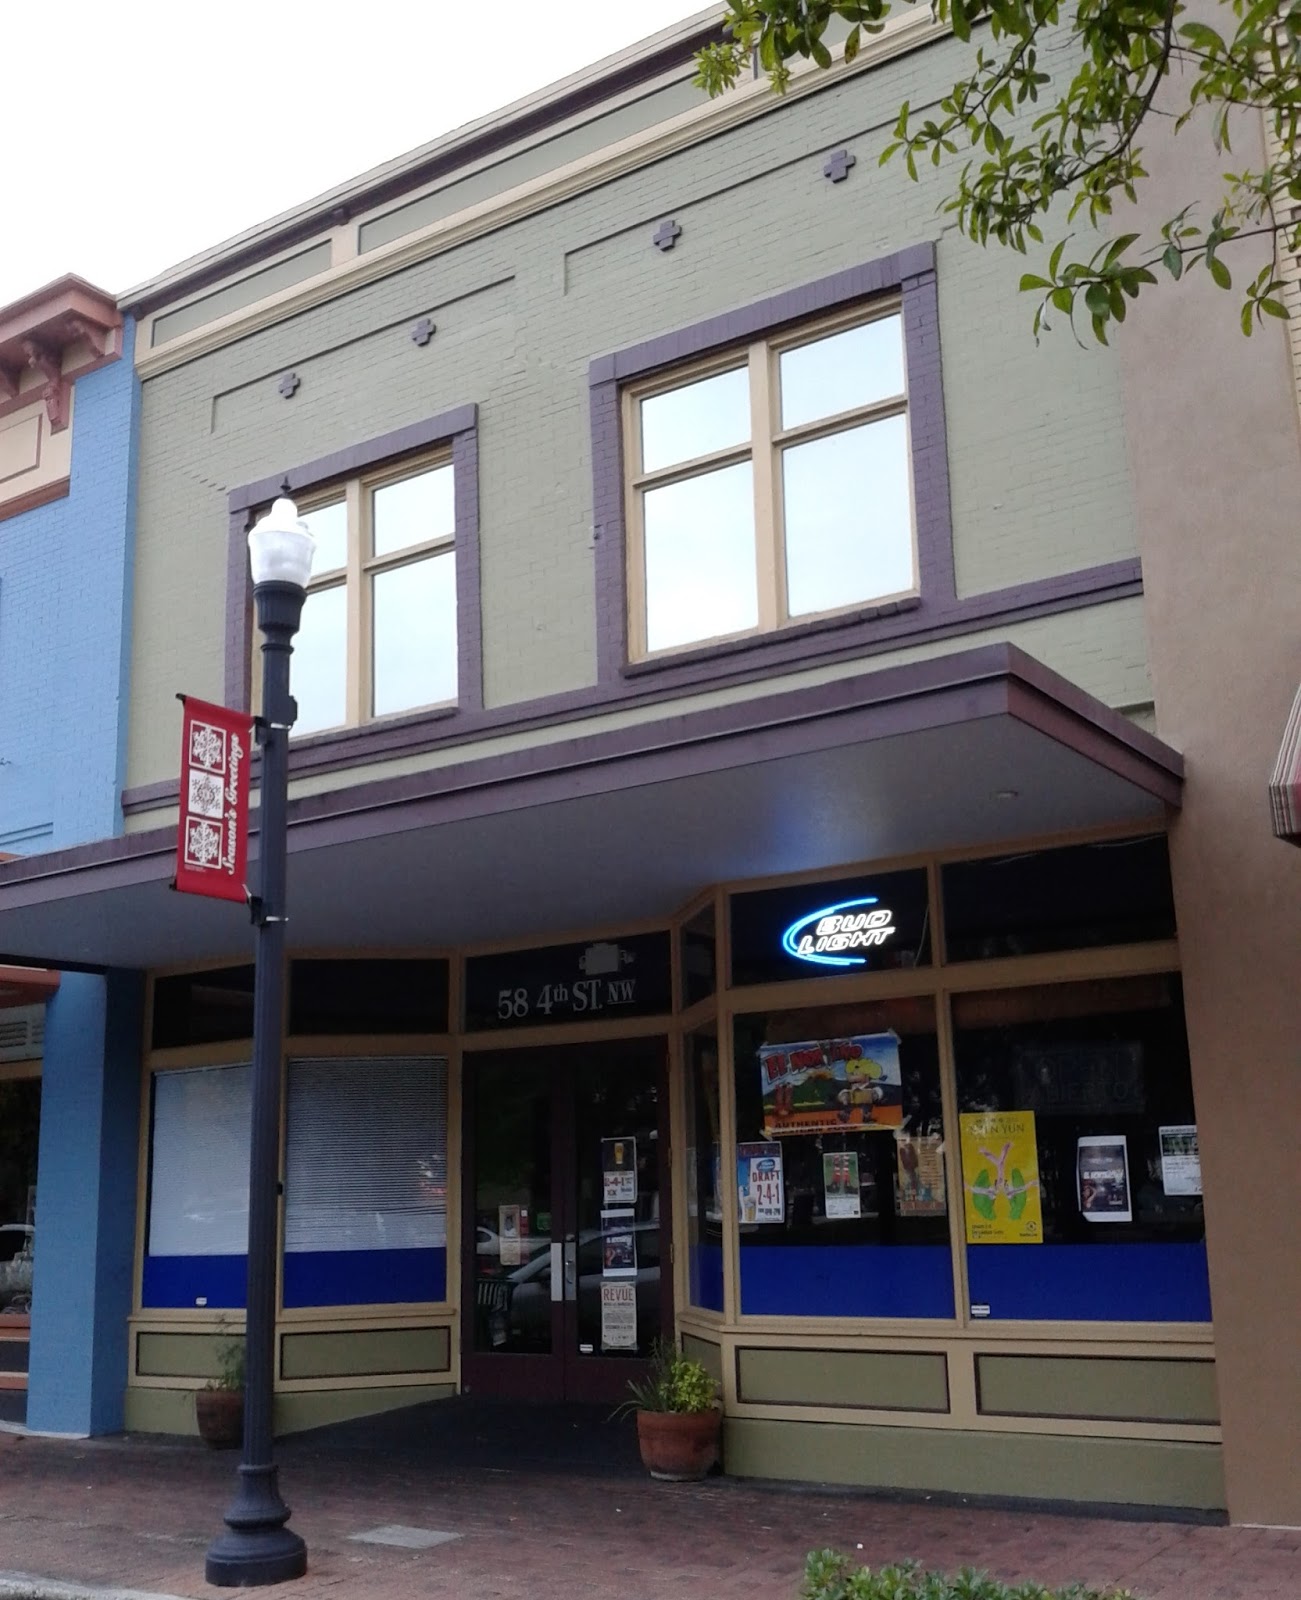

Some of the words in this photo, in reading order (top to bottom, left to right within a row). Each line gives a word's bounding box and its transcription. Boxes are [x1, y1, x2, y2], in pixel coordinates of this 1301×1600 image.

[225, 733, 244, 805] Greetings
[222, 808, 238, 875] Season's
[815, 909, 893, 936] BUD
[797, 926, 896, 955] LIGHT
[498, 988, 529, 1020] 58
[535, 984, 569, 1015] 4th
[607, 979, 636, 1005] NW
[1002, 1123, 1024, 1134] YUN
[752, 1170, 780, 1183] DRAFT
[757, 1183, 780, 1206] 2-4-1
[603, 1288, 634, 1301] REVUE
